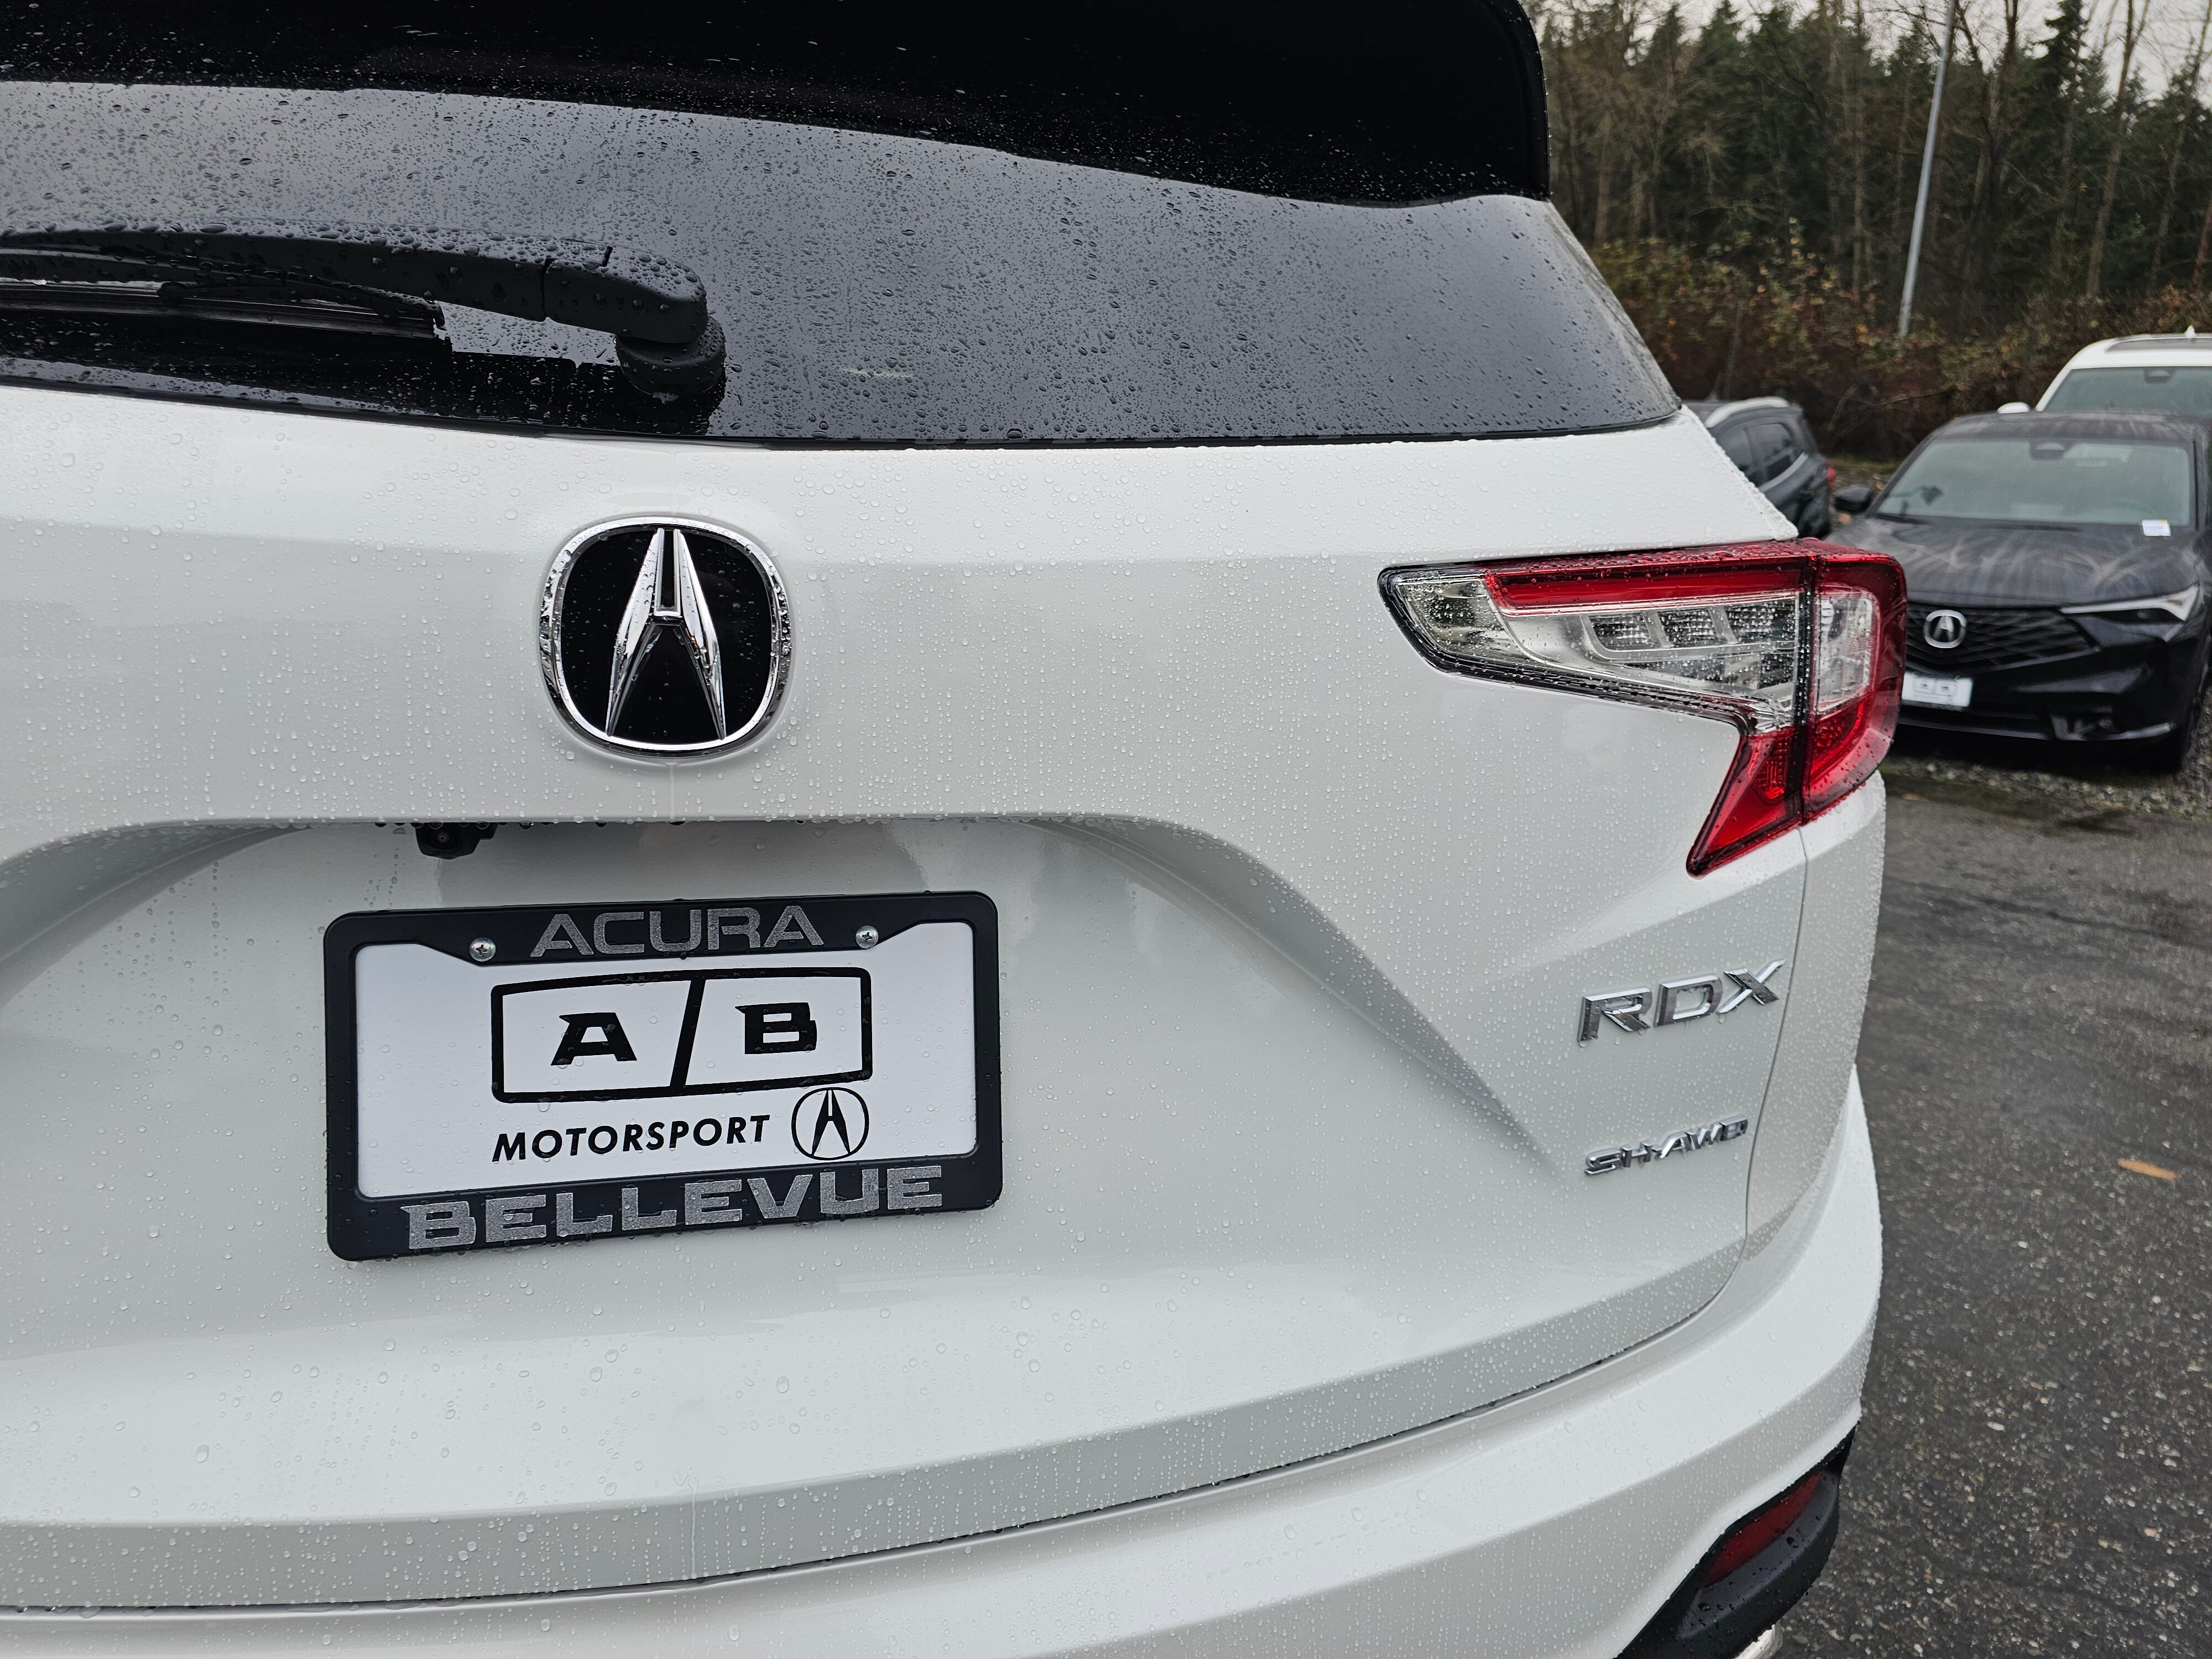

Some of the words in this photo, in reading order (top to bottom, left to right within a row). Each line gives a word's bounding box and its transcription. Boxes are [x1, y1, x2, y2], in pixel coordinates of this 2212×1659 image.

[530, 905, 824, 957] ACURA
[1577, 958, 1786, 1041] RDX
[550, 1012, 637, 1066] A
[734, 1002, 818, 1055] B
[492, 1115, 770, 1162] MOTORSPORT
[401, 1165, 942, 1249] BELLEVUE
